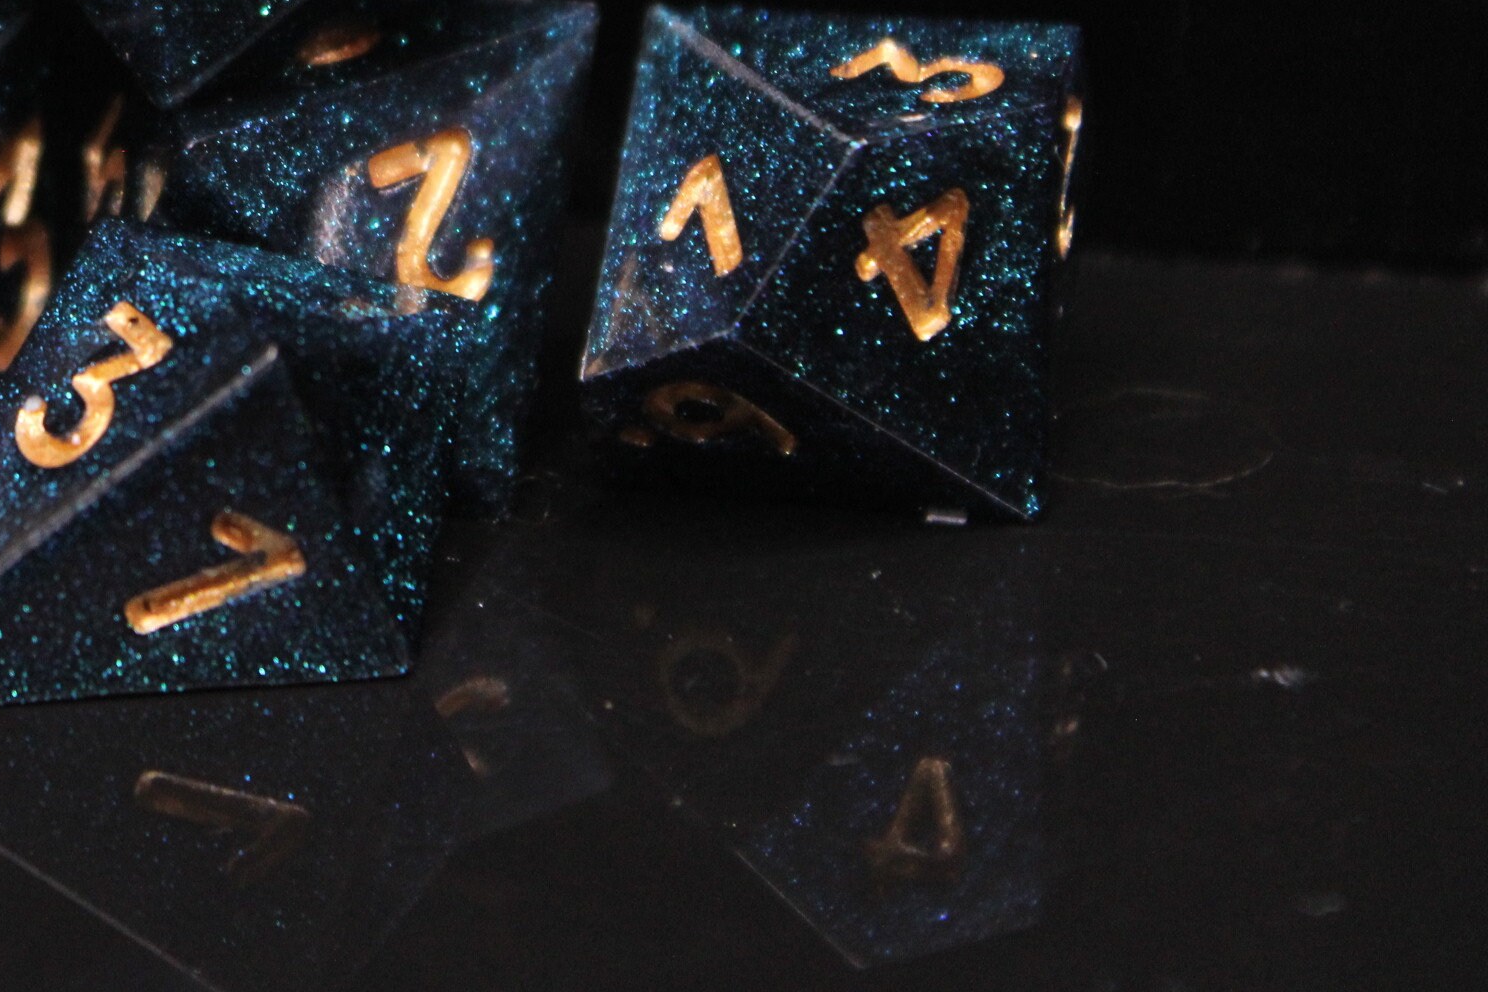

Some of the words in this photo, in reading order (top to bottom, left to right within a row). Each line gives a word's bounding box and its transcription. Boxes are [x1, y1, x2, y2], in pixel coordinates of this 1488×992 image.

[828, 36, 1007, 105] 3
[366, 124, 496, 313] 2
[853, 187, 971, 343] 4
[14, 300, 174, 471] 3
